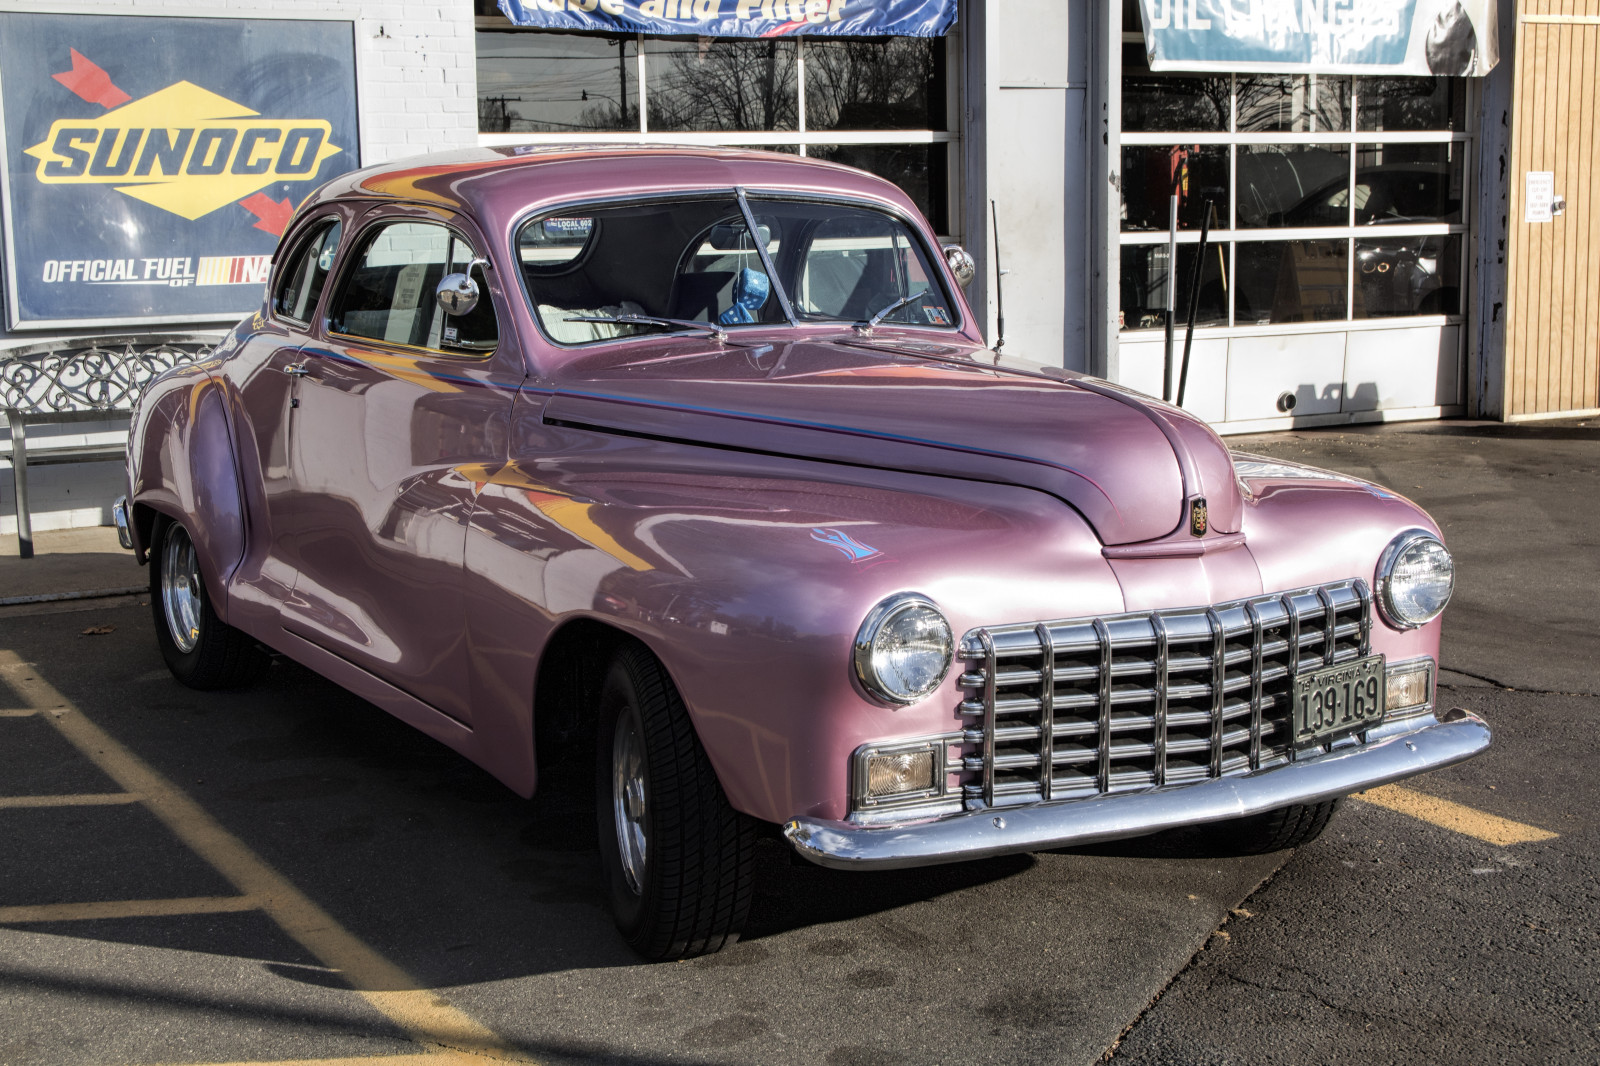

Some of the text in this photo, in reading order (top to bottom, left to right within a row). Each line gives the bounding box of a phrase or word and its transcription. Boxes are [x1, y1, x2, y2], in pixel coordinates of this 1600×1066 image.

[44, 127, 326, 176] SUNOCO
[557, 220, 579, 228] LOCAL
[42, 258, 138, 283] OFFICIAL
[140, 256, 195, 280] FUEL
[169, 278, 194, 288] OF
[1316, 667, 1361, 687] VIRGINIA
